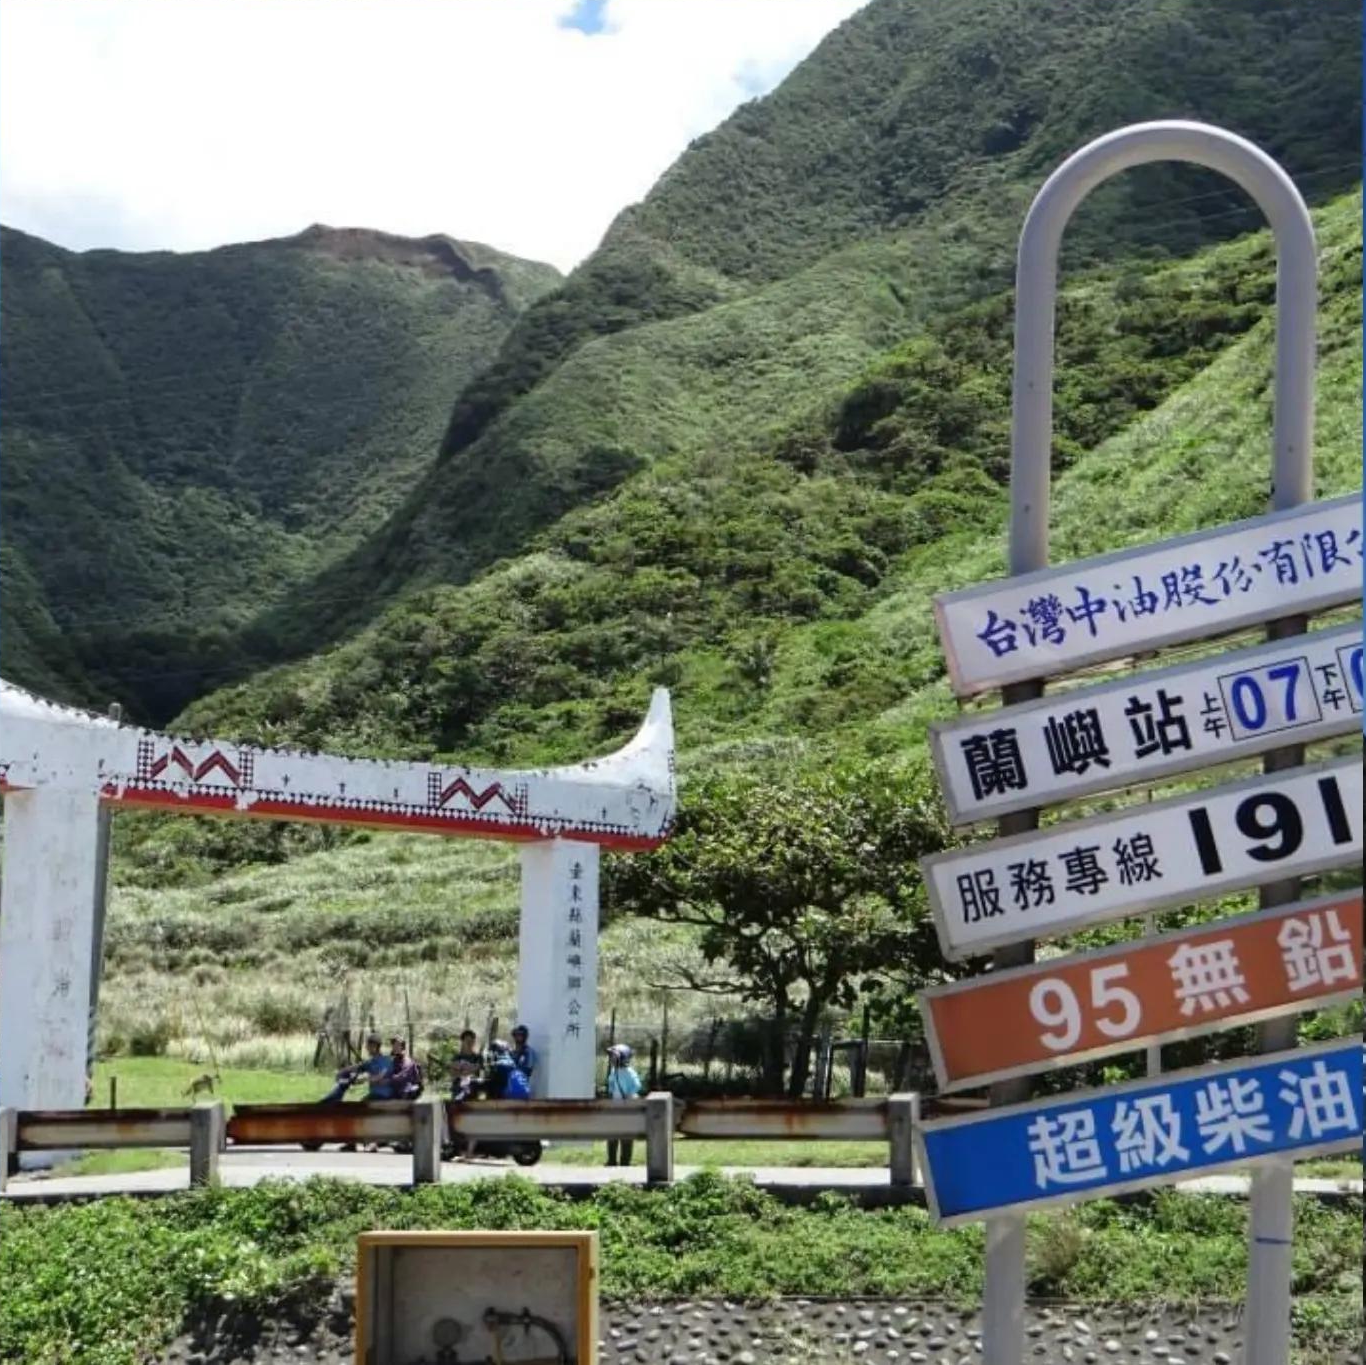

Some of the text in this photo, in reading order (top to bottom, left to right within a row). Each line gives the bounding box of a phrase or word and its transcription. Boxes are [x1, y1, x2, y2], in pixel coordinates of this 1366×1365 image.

[960, 687, 1192, 801] 蘭嶼站
[1231, 663, 1301, 731] 07
[956, 775, 1353, 924] 服務專線 191
[1027, 1068, 1359, 1191] 超級柴油
